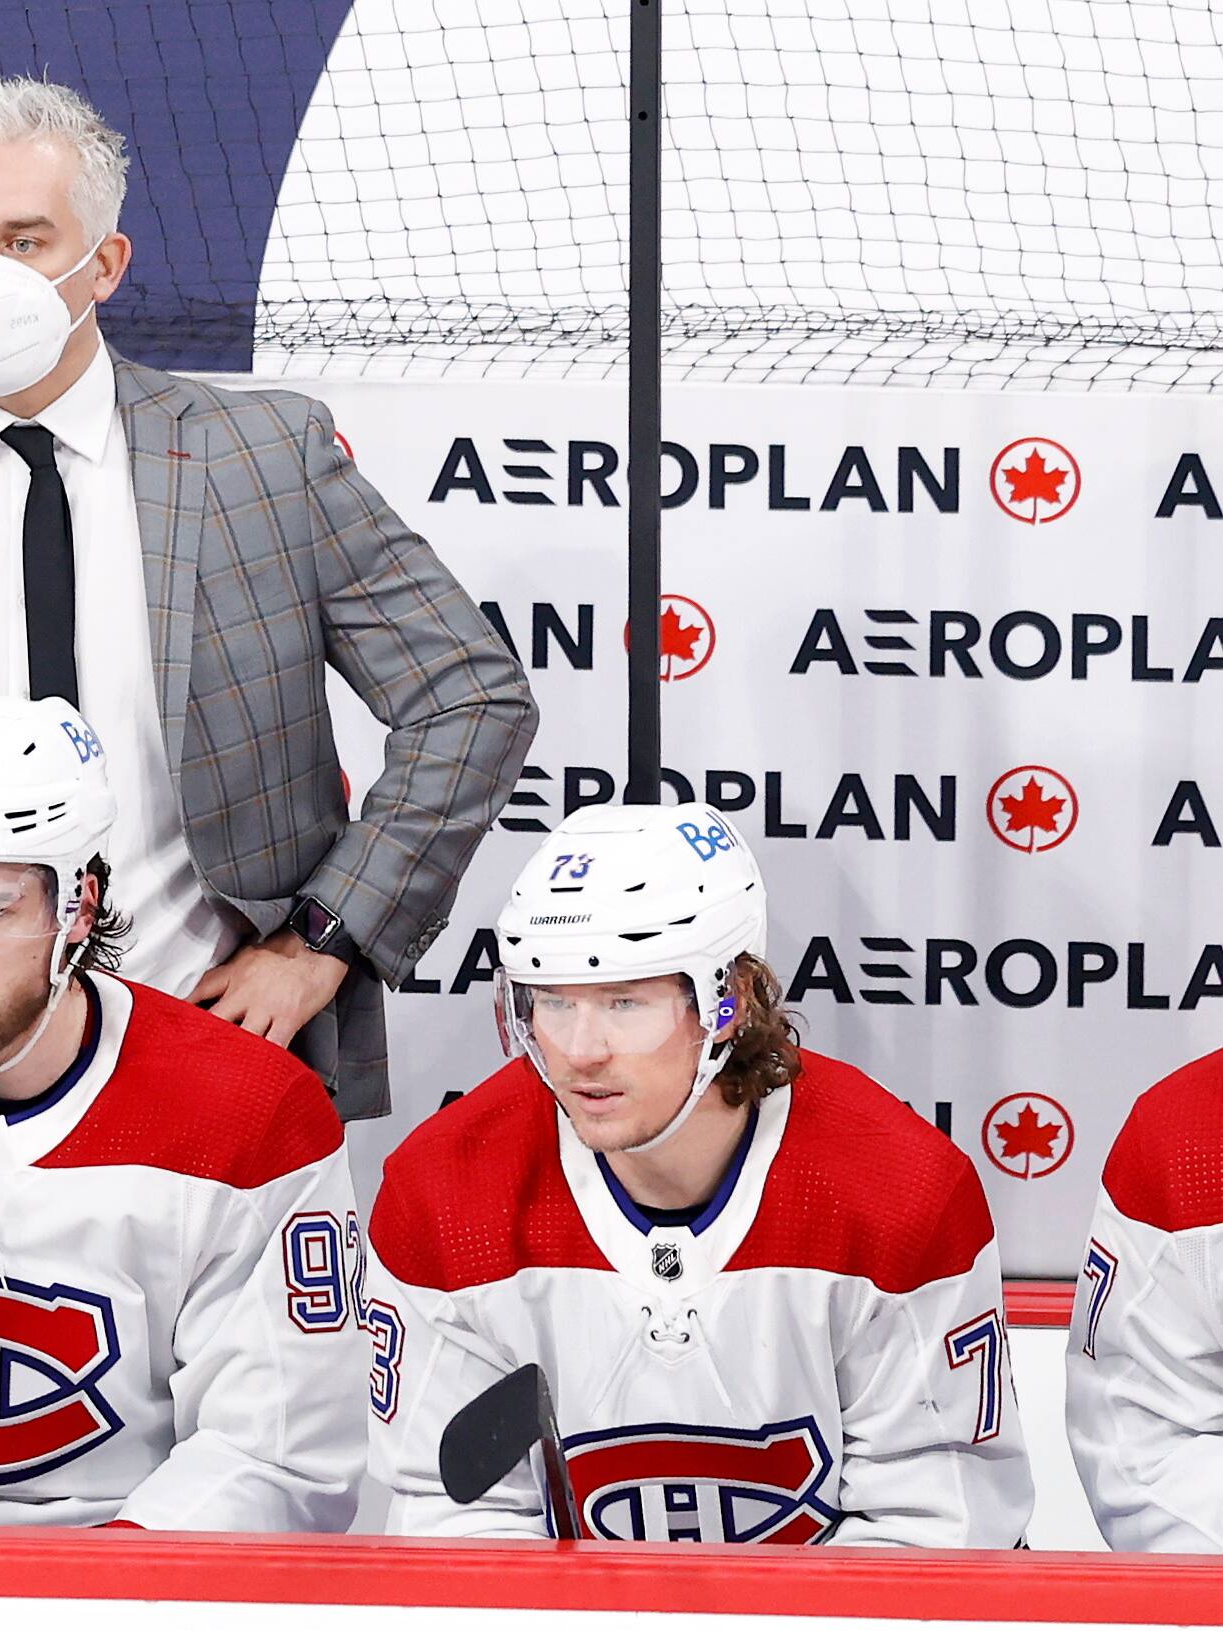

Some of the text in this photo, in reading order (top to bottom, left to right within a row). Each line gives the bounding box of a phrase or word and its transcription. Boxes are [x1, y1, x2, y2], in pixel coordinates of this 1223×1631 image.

[549, 853, 595, 881] 73
[676, 809, 739, 862] Bell
[367, 1298, 406, 1424] 3
[943, 1308, 1007, 1445] 7
